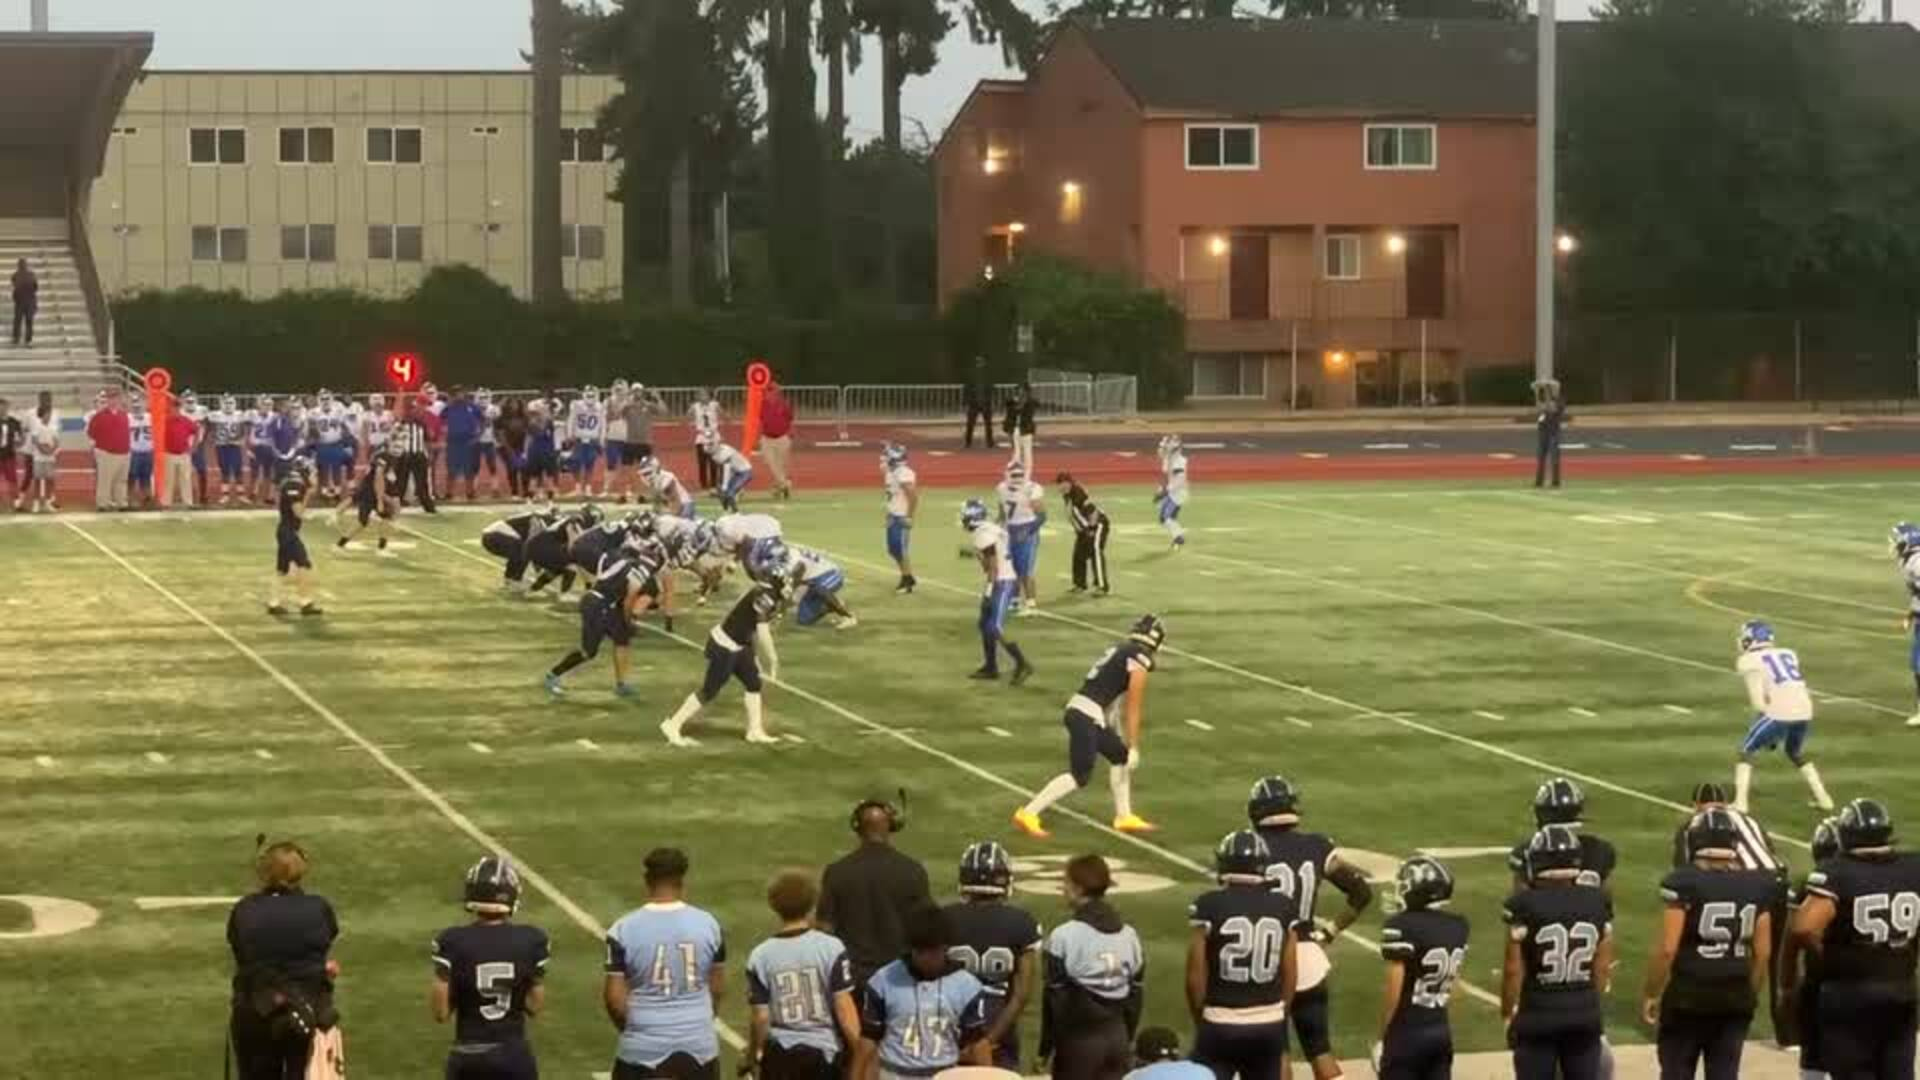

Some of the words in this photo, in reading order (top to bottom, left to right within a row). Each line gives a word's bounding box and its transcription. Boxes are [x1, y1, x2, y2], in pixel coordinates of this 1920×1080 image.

[393, 357, 411, 383] 4
[577, 414, 599, 430] 50
[1761, 653, 1805, 684] 16
[1696, 901, 1757, 959] 51
[1853, 891, 1920, 949] 59
[651, 943, 699, 996] 41
[1219, 915, 1283, 983] 20
[1535, 921, 1599, 985] 32
[475, 961, 516, 1021] 5
[901, 1014, 952, 1058] 47
